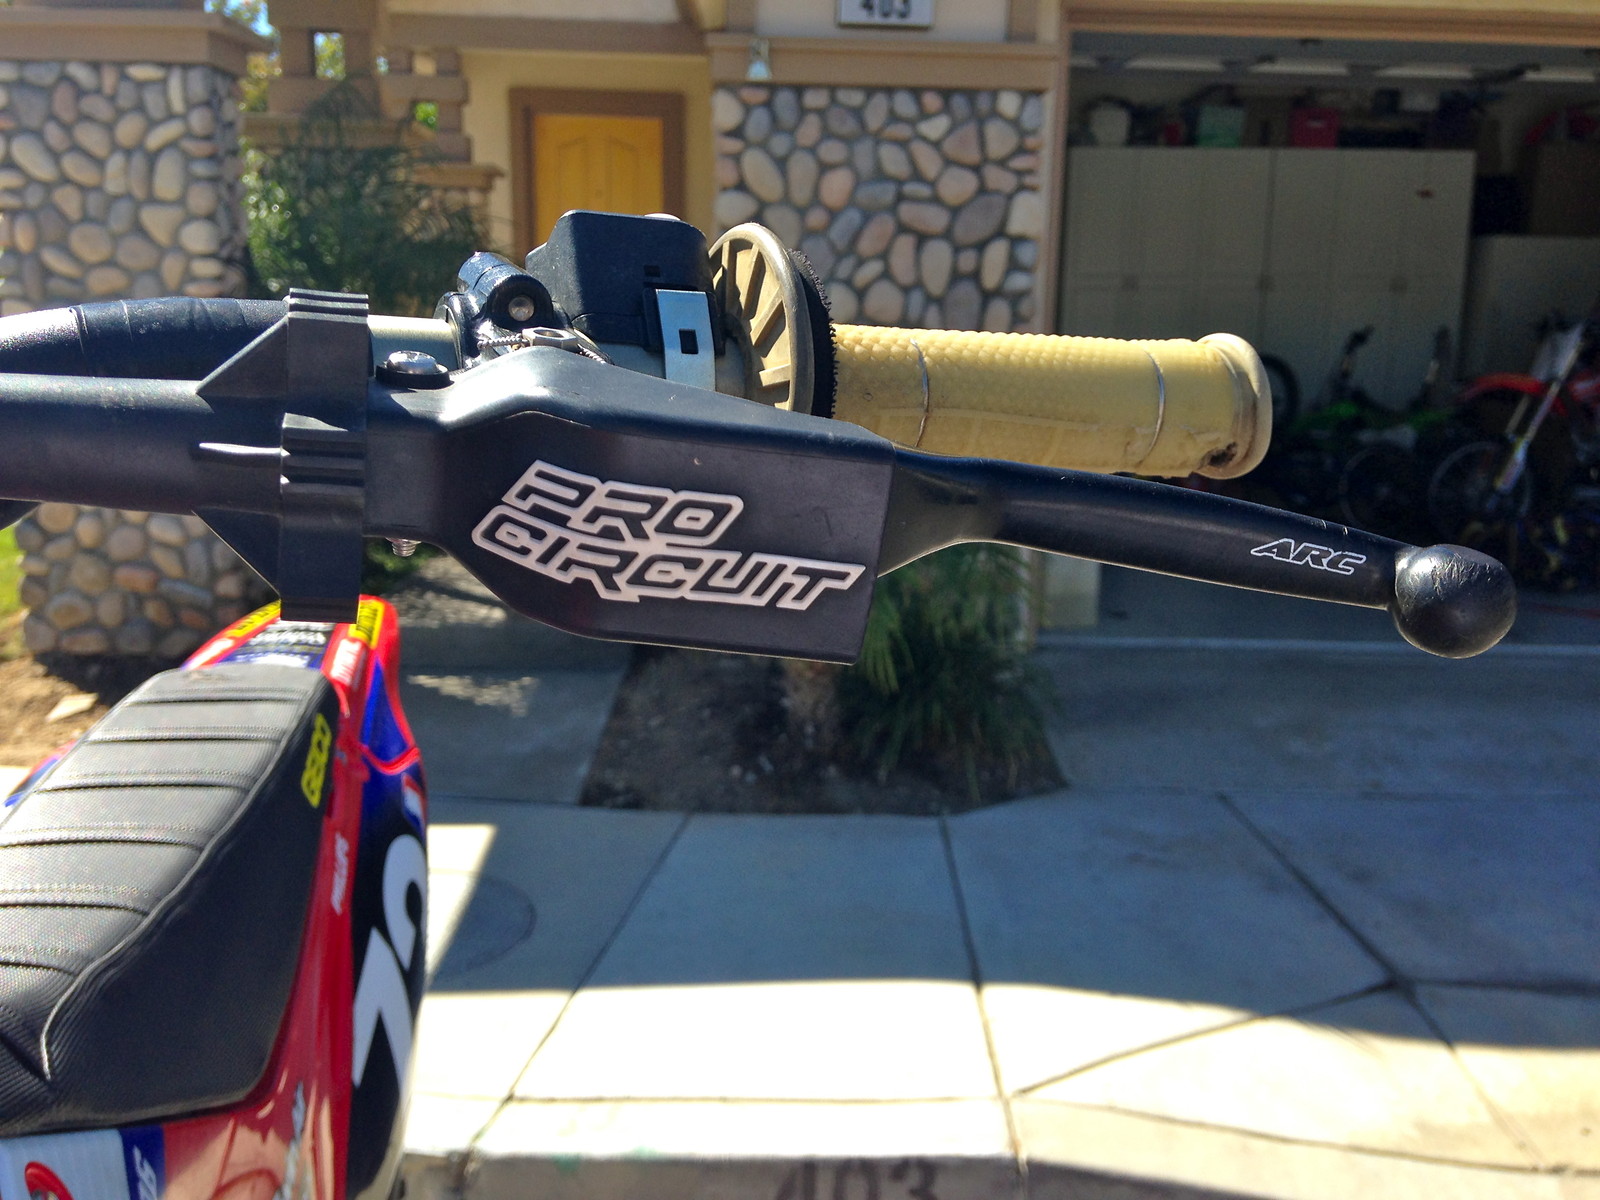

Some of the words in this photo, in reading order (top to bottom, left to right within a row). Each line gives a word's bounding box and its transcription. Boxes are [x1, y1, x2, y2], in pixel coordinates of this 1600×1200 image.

[502, 459, 744, 546] PRO
[471, 504, 867, 611] CIRCUIT
[1250, 537, 1367, 576] ARC
